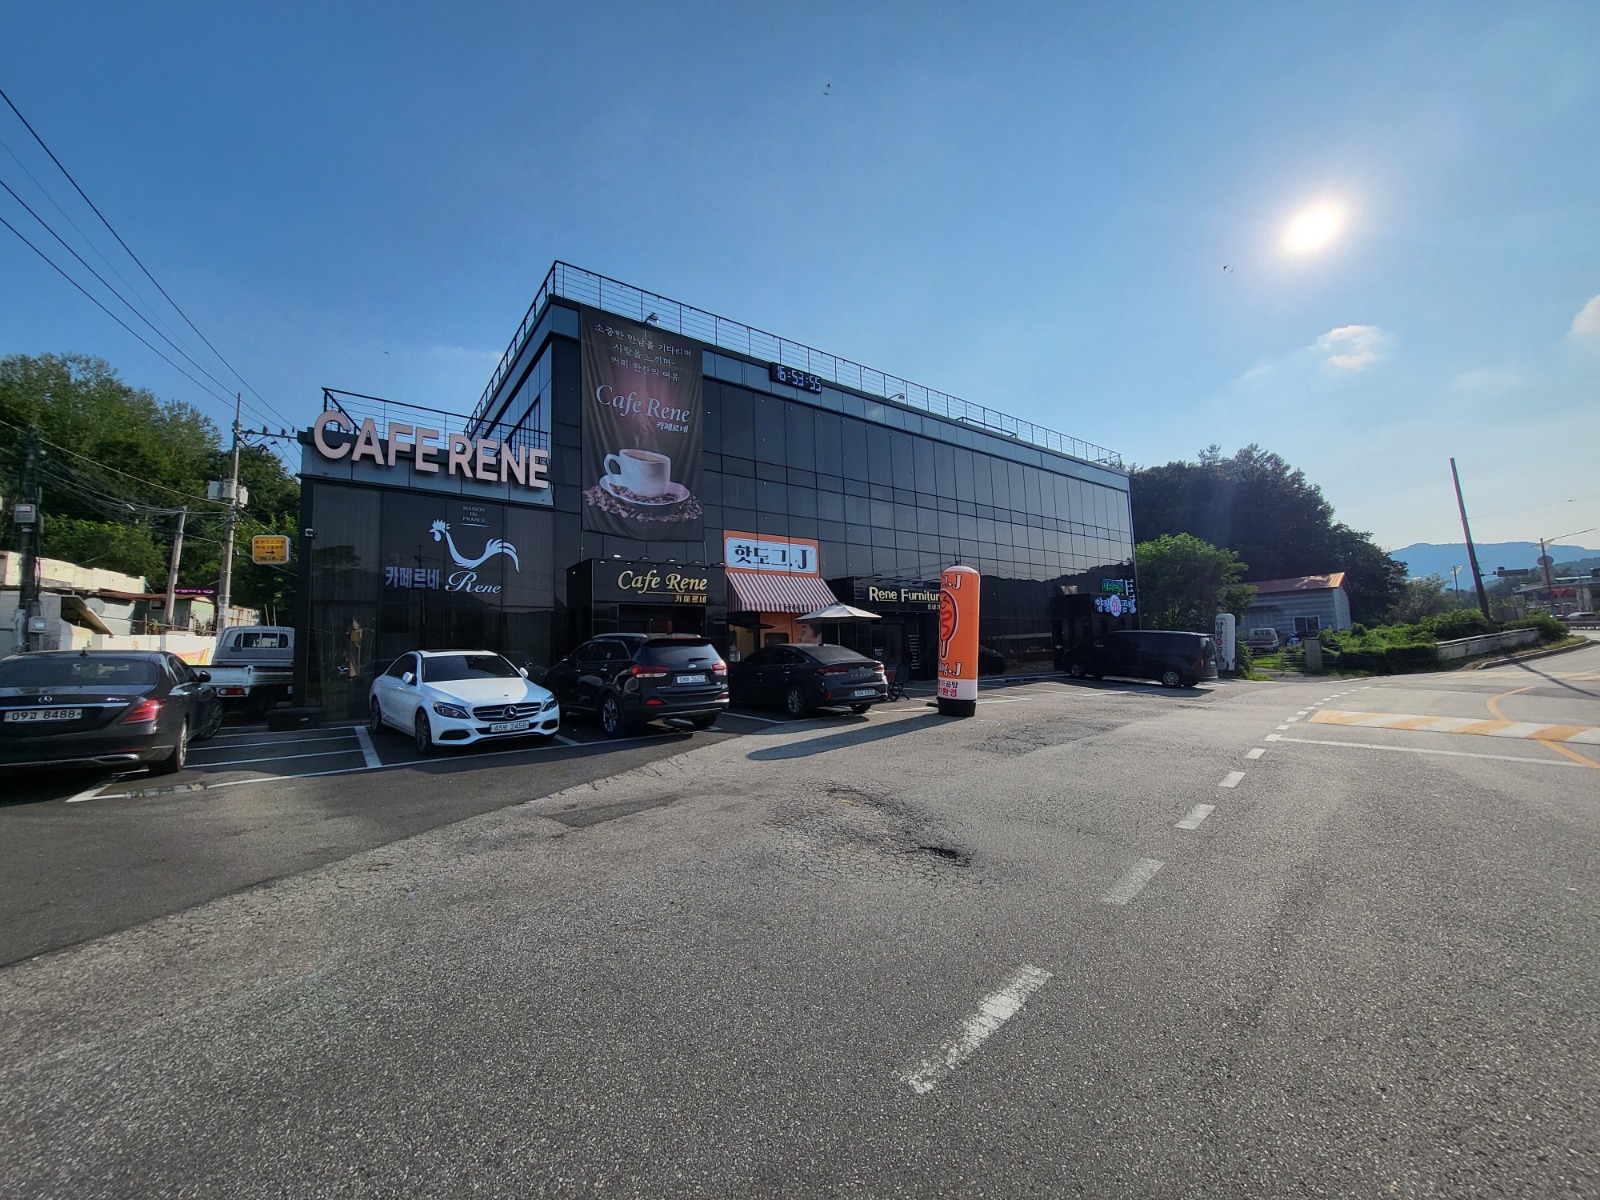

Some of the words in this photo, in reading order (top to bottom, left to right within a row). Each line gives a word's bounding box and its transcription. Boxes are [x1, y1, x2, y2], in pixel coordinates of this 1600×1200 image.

[594, 323, 625, 341] 소중한
[627, 334, 655, 350] 만남을
[613, 343, 642, 359] 사랑을
[610, 356, 629, 369] 커피
[632, 362, 660, 377] 한잔의
[662, 371, 680, 382] 여유
[595, 384, 642, 417] Cafe
[645, 397, 691, 423] Rene
[655, 421, 689, 434] 카페르네
[313, 410, 440, 474] CAFE
[448, 432, 549, 489] RENE
[462, 505, 486, 513] MAISON
[385, 566, 440, 590] 카페르네
[445, 570, 502, 594] Rene
[617, 569, 661, 594] Cafe
[665, 573, 708, 593] Rene
[674, 594, 707, 604] 카페르네
[868, 586, 898, 602] Rene
[900, 588, 941, 603] Furnitur
[43, 709, 76, 720] 8488
